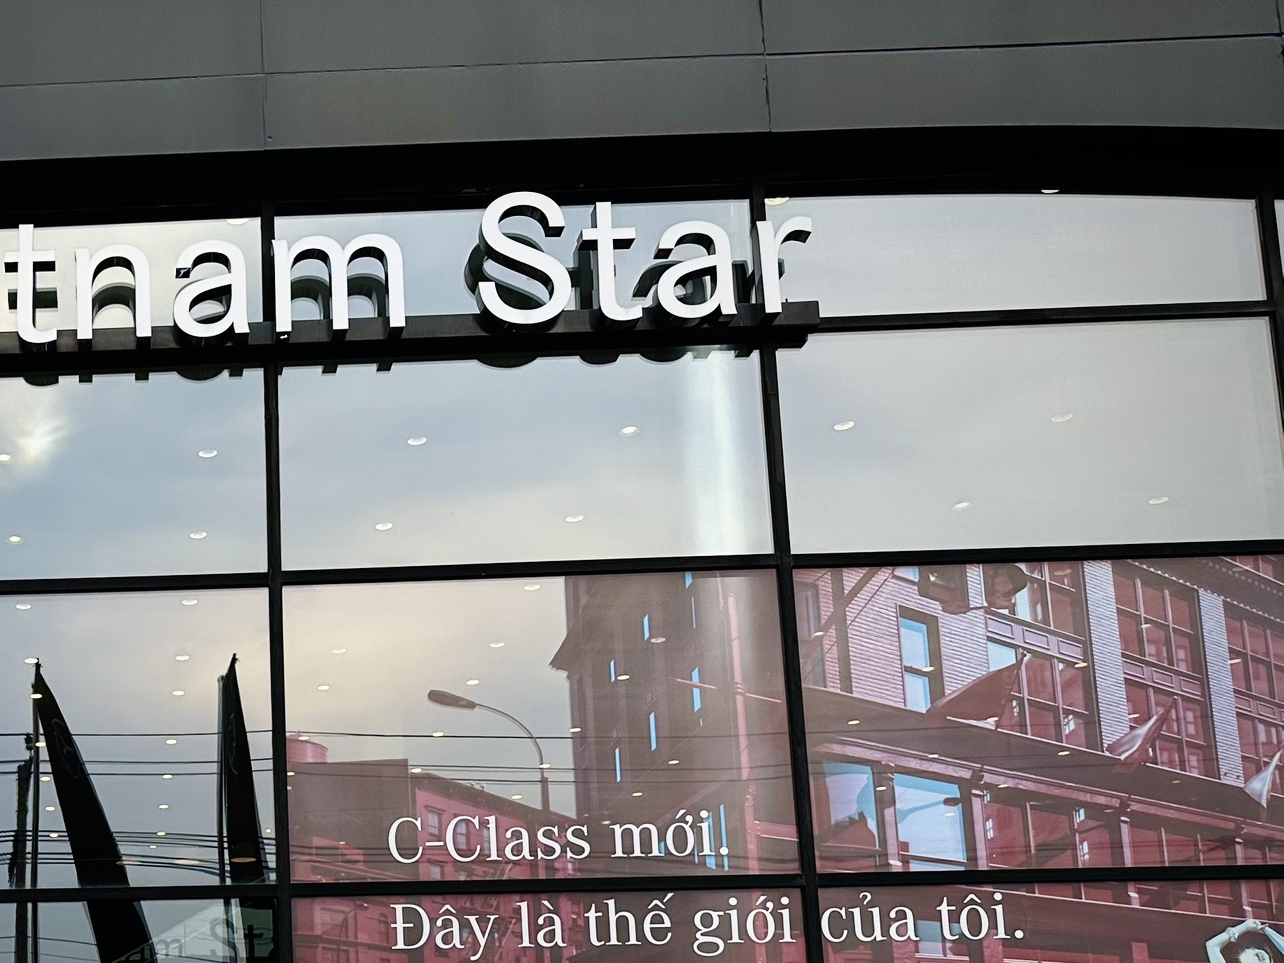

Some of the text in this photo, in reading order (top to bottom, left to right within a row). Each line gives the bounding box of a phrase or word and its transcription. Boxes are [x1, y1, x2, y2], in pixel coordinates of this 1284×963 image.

[475, 190, 814, 326] Star
[388, 815, 593, 864] C-Class
[389, 891, 1025, 961] Đây là thế giới của tôi.
